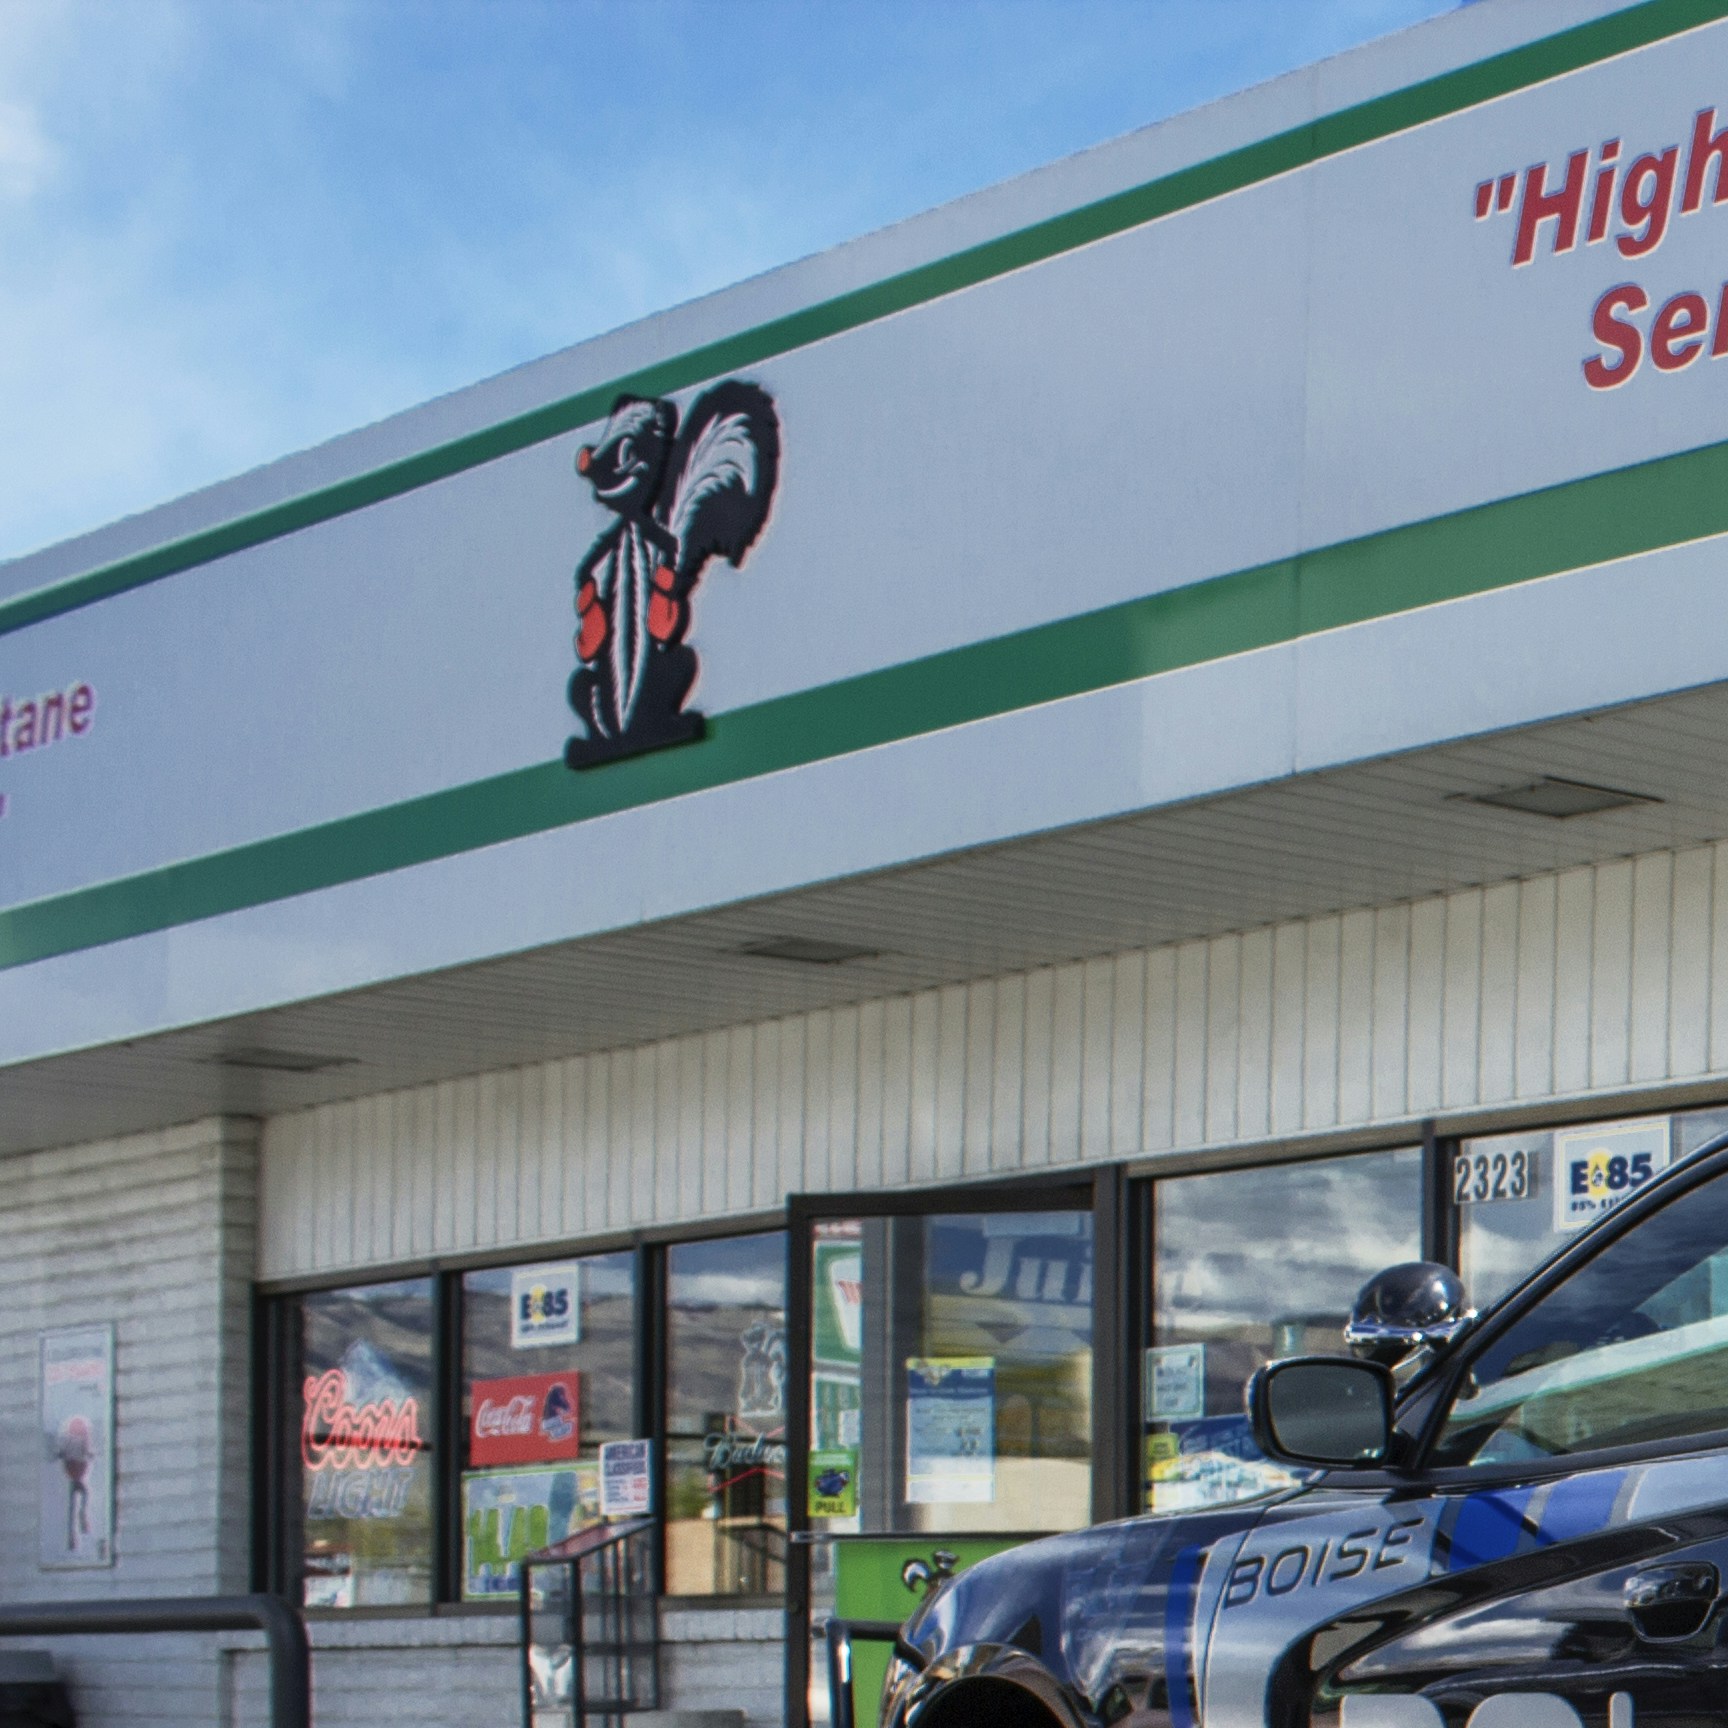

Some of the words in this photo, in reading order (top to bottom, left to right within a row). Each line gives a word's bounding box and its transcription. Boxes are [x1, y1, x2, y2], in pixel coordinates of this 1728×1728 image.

[1455, 1150, 1527, 1202] 2323
[307, 1468, 418, 1520] LIGHT
[1223, 1516, 1425, 1610] BOISE
